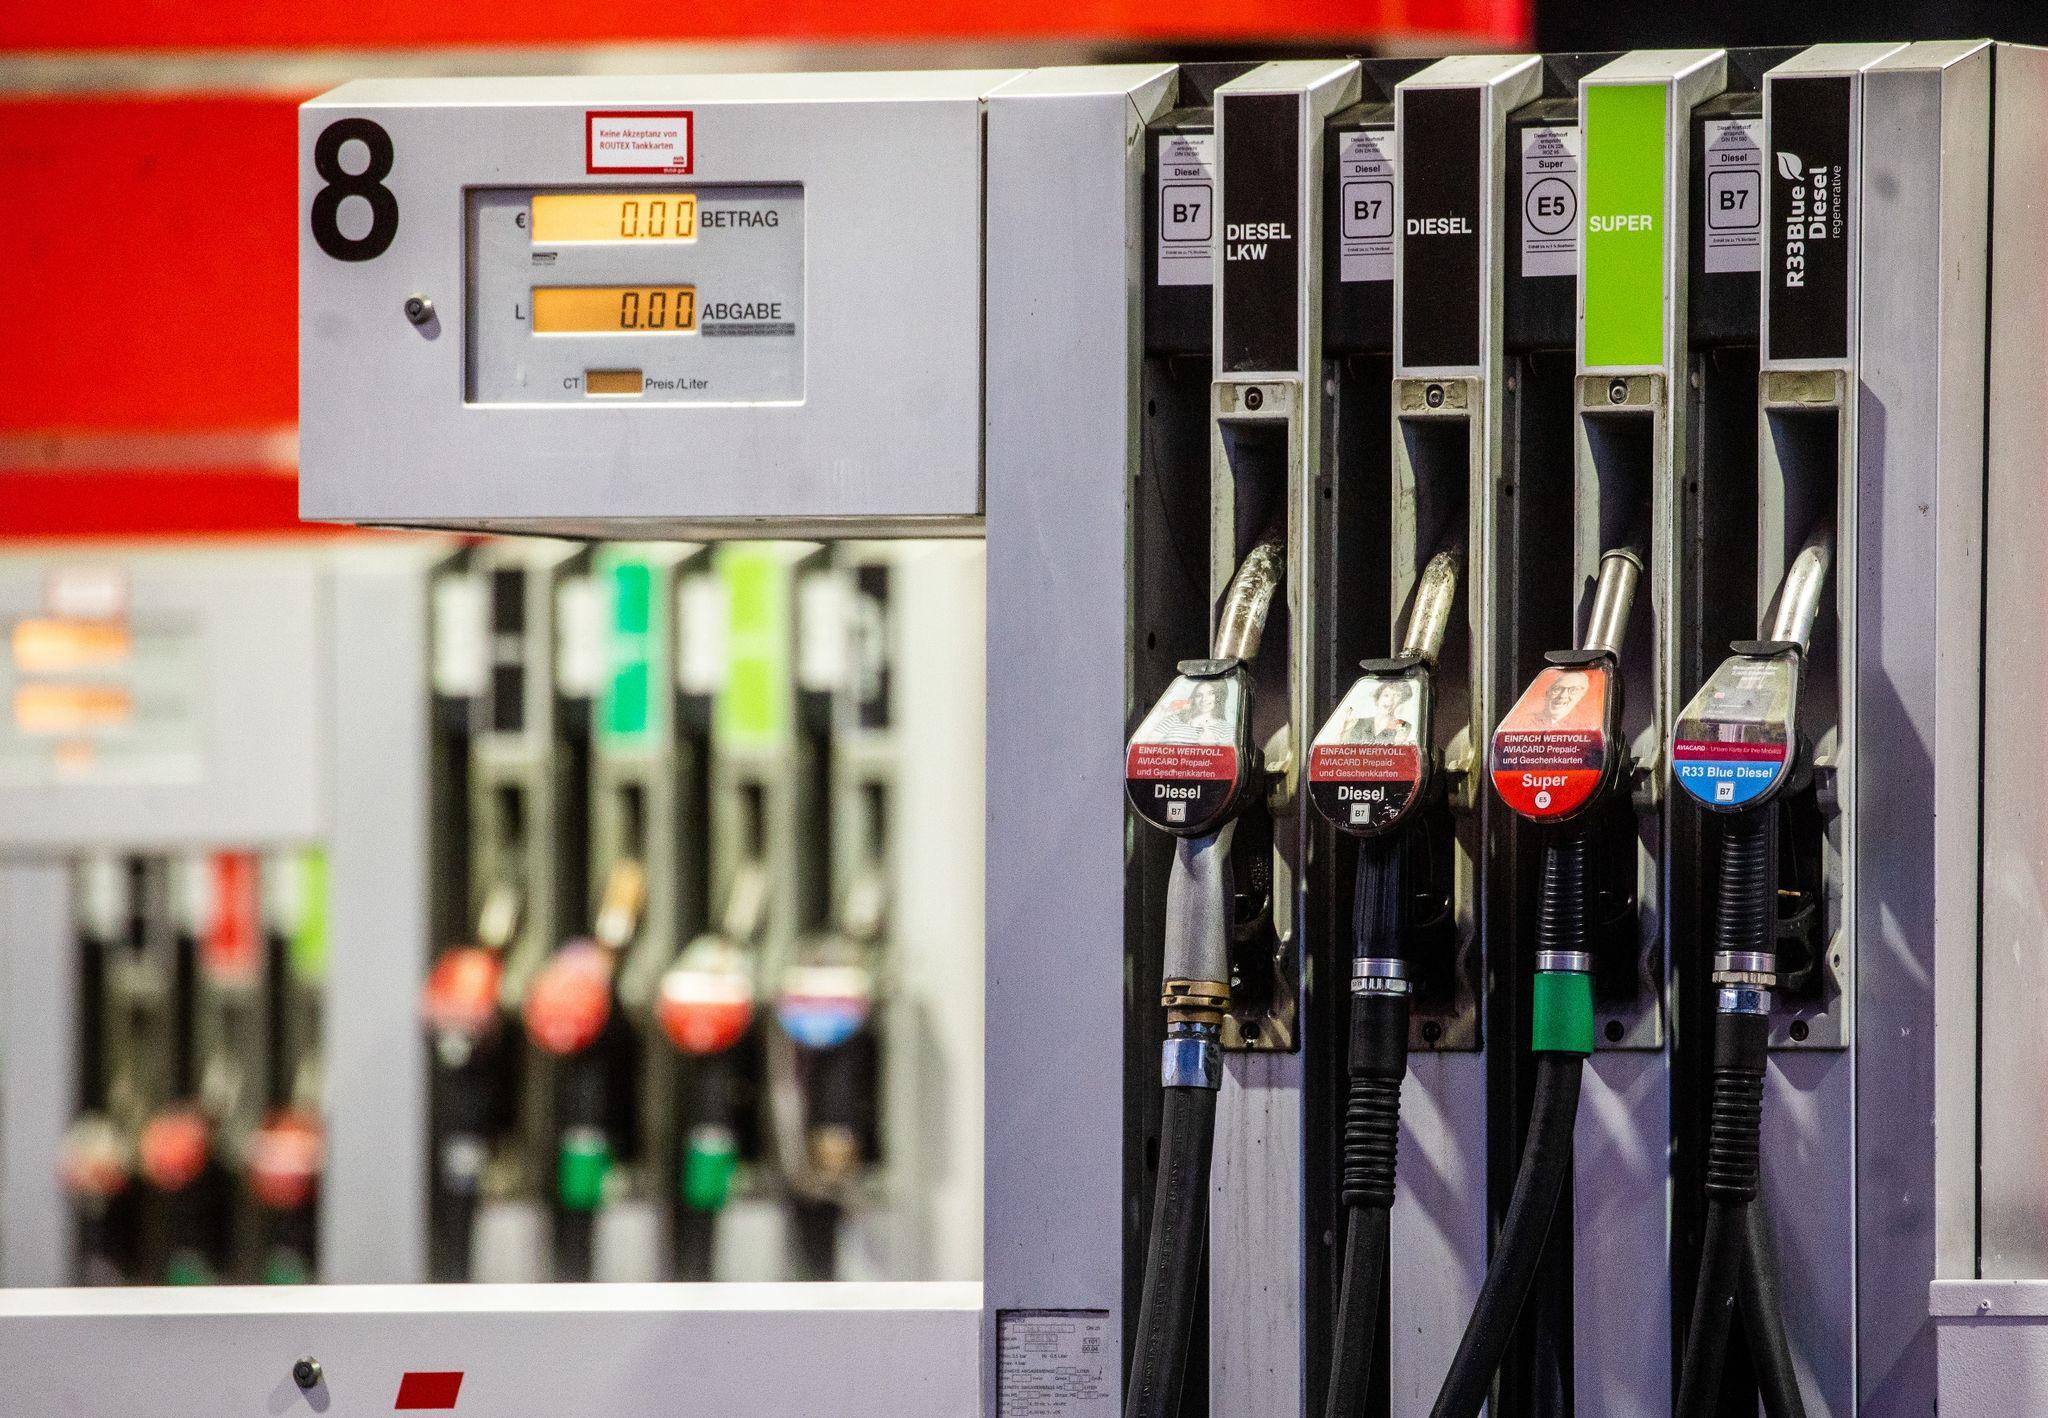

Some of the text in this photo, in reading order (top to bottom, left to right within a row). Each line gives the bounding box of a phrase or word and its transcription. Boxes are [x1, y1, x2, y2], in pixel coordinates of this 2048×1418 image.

[600, 130, 621, 138] Keine
[622, 129, 661, 139] Akzeptanz
[600, 141, 673, 150] ROUTEX Tankkarten
[1538, 160, 1563, 169] Super
[1721, 154, 1747, 162] Diesel
[1355, 165, 1381, 173] Diesel
[311, 118, 399, 262] 8
[1537, 196, 1565, 217] E5
[1720, 189, 1749, 210] B7
[1808, 166, 1828, 239] Diesel
[1831, 165, 1843, 239] regenerative
[1173, 204, 1201, 223] B7
[1354, 199, 1382, 220] B7
[515, 213, 526, 229] €
[620, 201, 694, 238] 0.00
[701, 210, 779, 228] BETRAG
[1407, 217, 1472, 235] DIESEL
[1589, 215, 1653, 232] SUPER
[1226, 223, 1292, 241] DIESEL
[1226, 244, 1268, 261] LKW
[515, 304, 525, 320] L
[620, 292, 694, 329] 0.00
[702, 303, 782, 320] ABGABE
[563, 378, 579, 389] CT
[645, 378, 674, 389] Preis
[1504, 734, 1591, 742] EINFACH WERTVOLL.
[1138, 746, 1223, 757] EINFACH WERTVOLL.
[1320, 747, 1406, 756] EINFACH WERTVOLL.
[1503, 745, 1580, 754] AVIACARD Prepaid-
[1676, 744, 1706, 752] AVIACARD
[1137, 757, 1213, 768] AVIACARD Prepaid-
[1319, 758, 1396, 767] AVIACARD Prepaid-
[1502, 756, 1583, 764] und Geschenkkarten
[1153, 768, 1216, 778] Geschenkkarten
[1319, 769, 1398, 778] und Geschenkkarten
[1682, 766, 1773, 778] R33 Blue Diesel
[1521, 773, 1568, 791] Super
[1154, 784, 1201, 799] Diesel
[1337, 786, 1385, 800] Diesel
